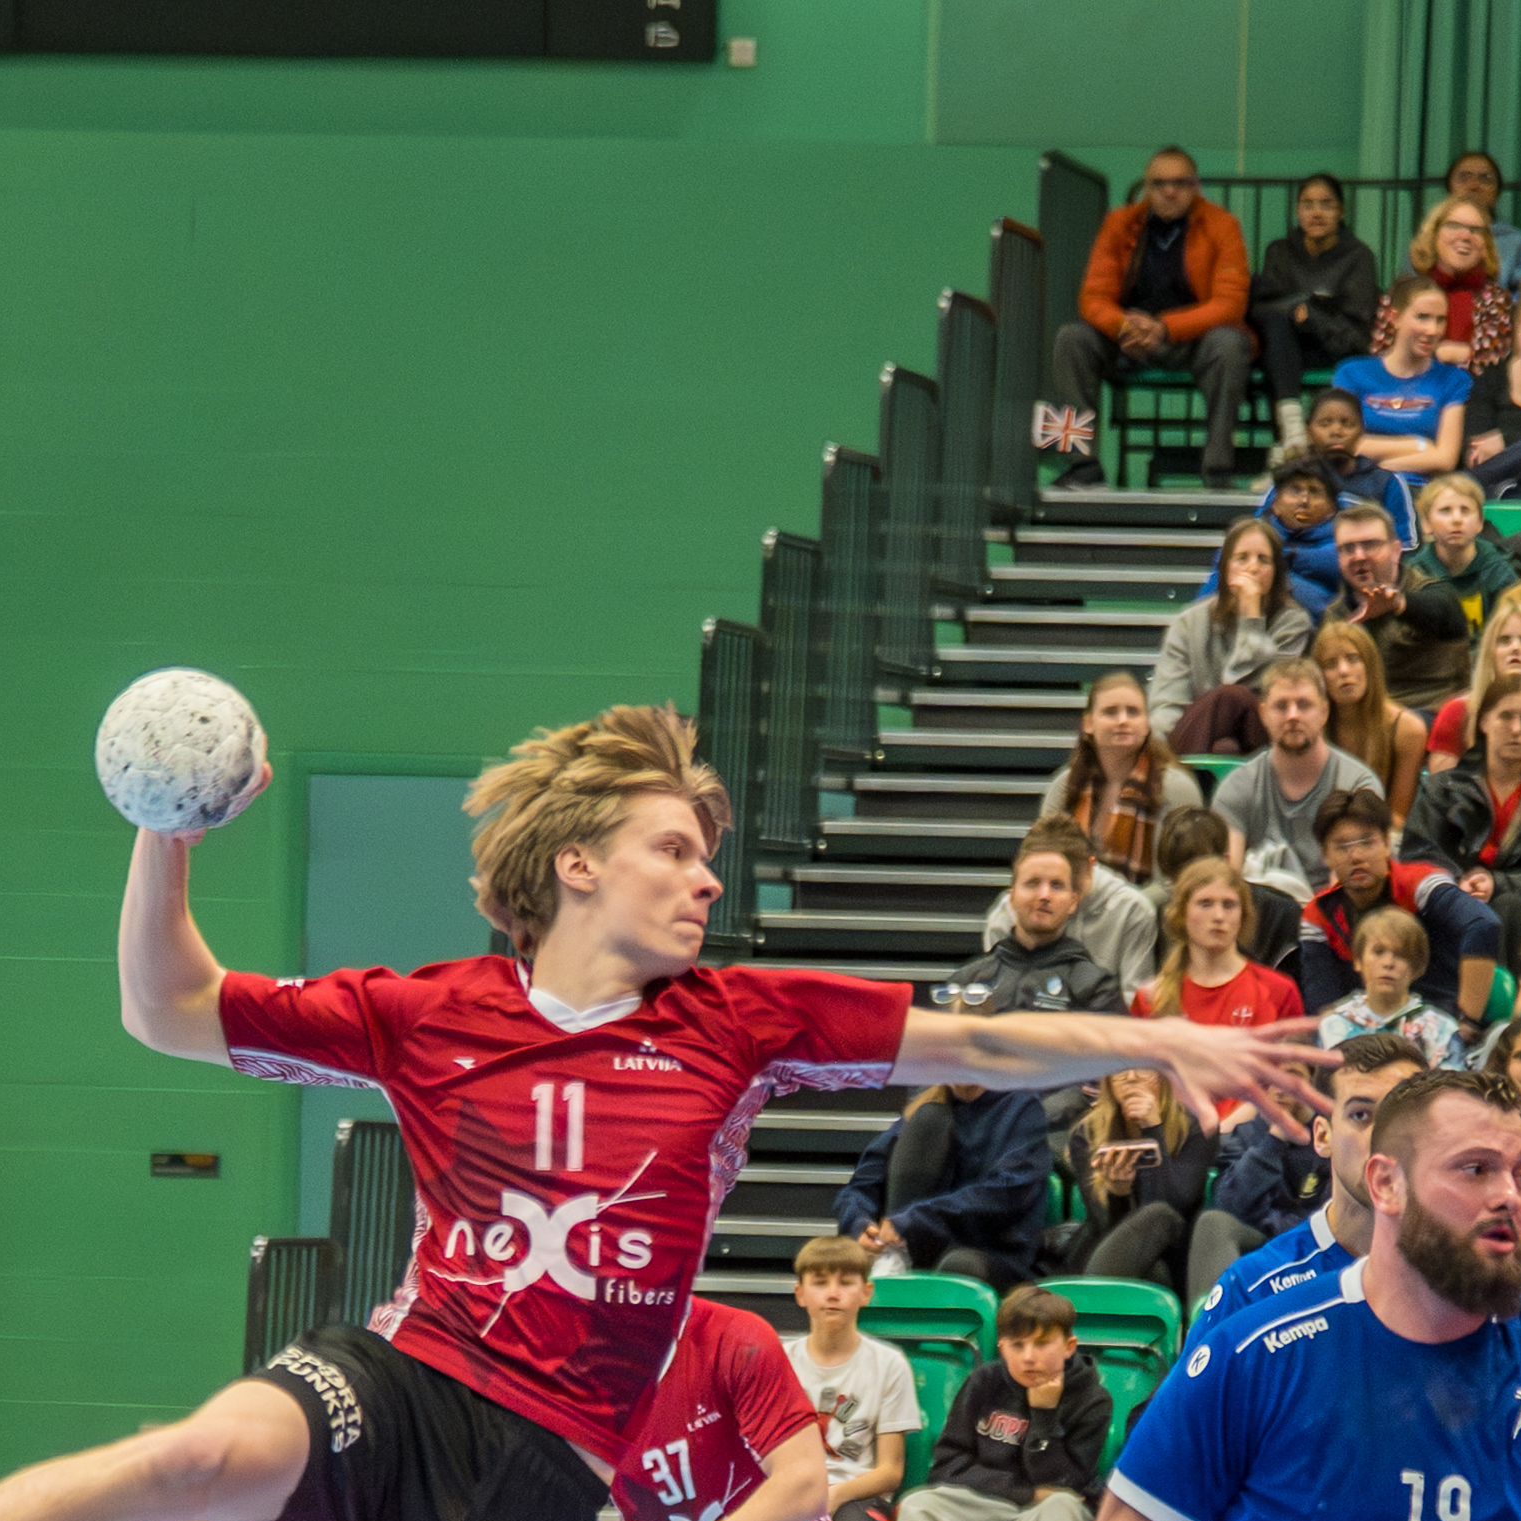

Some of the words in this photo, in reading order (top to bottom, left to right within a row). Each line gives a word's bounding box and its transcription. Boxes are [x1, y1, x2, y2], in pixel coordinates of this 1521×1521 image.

[531, 1081, 586, 1171] 11
[604, 1279, 676, 1305] fibers
[1263, 1316, 1329, 1354] Kempa
[641, 1438, 697, 1506] 37
